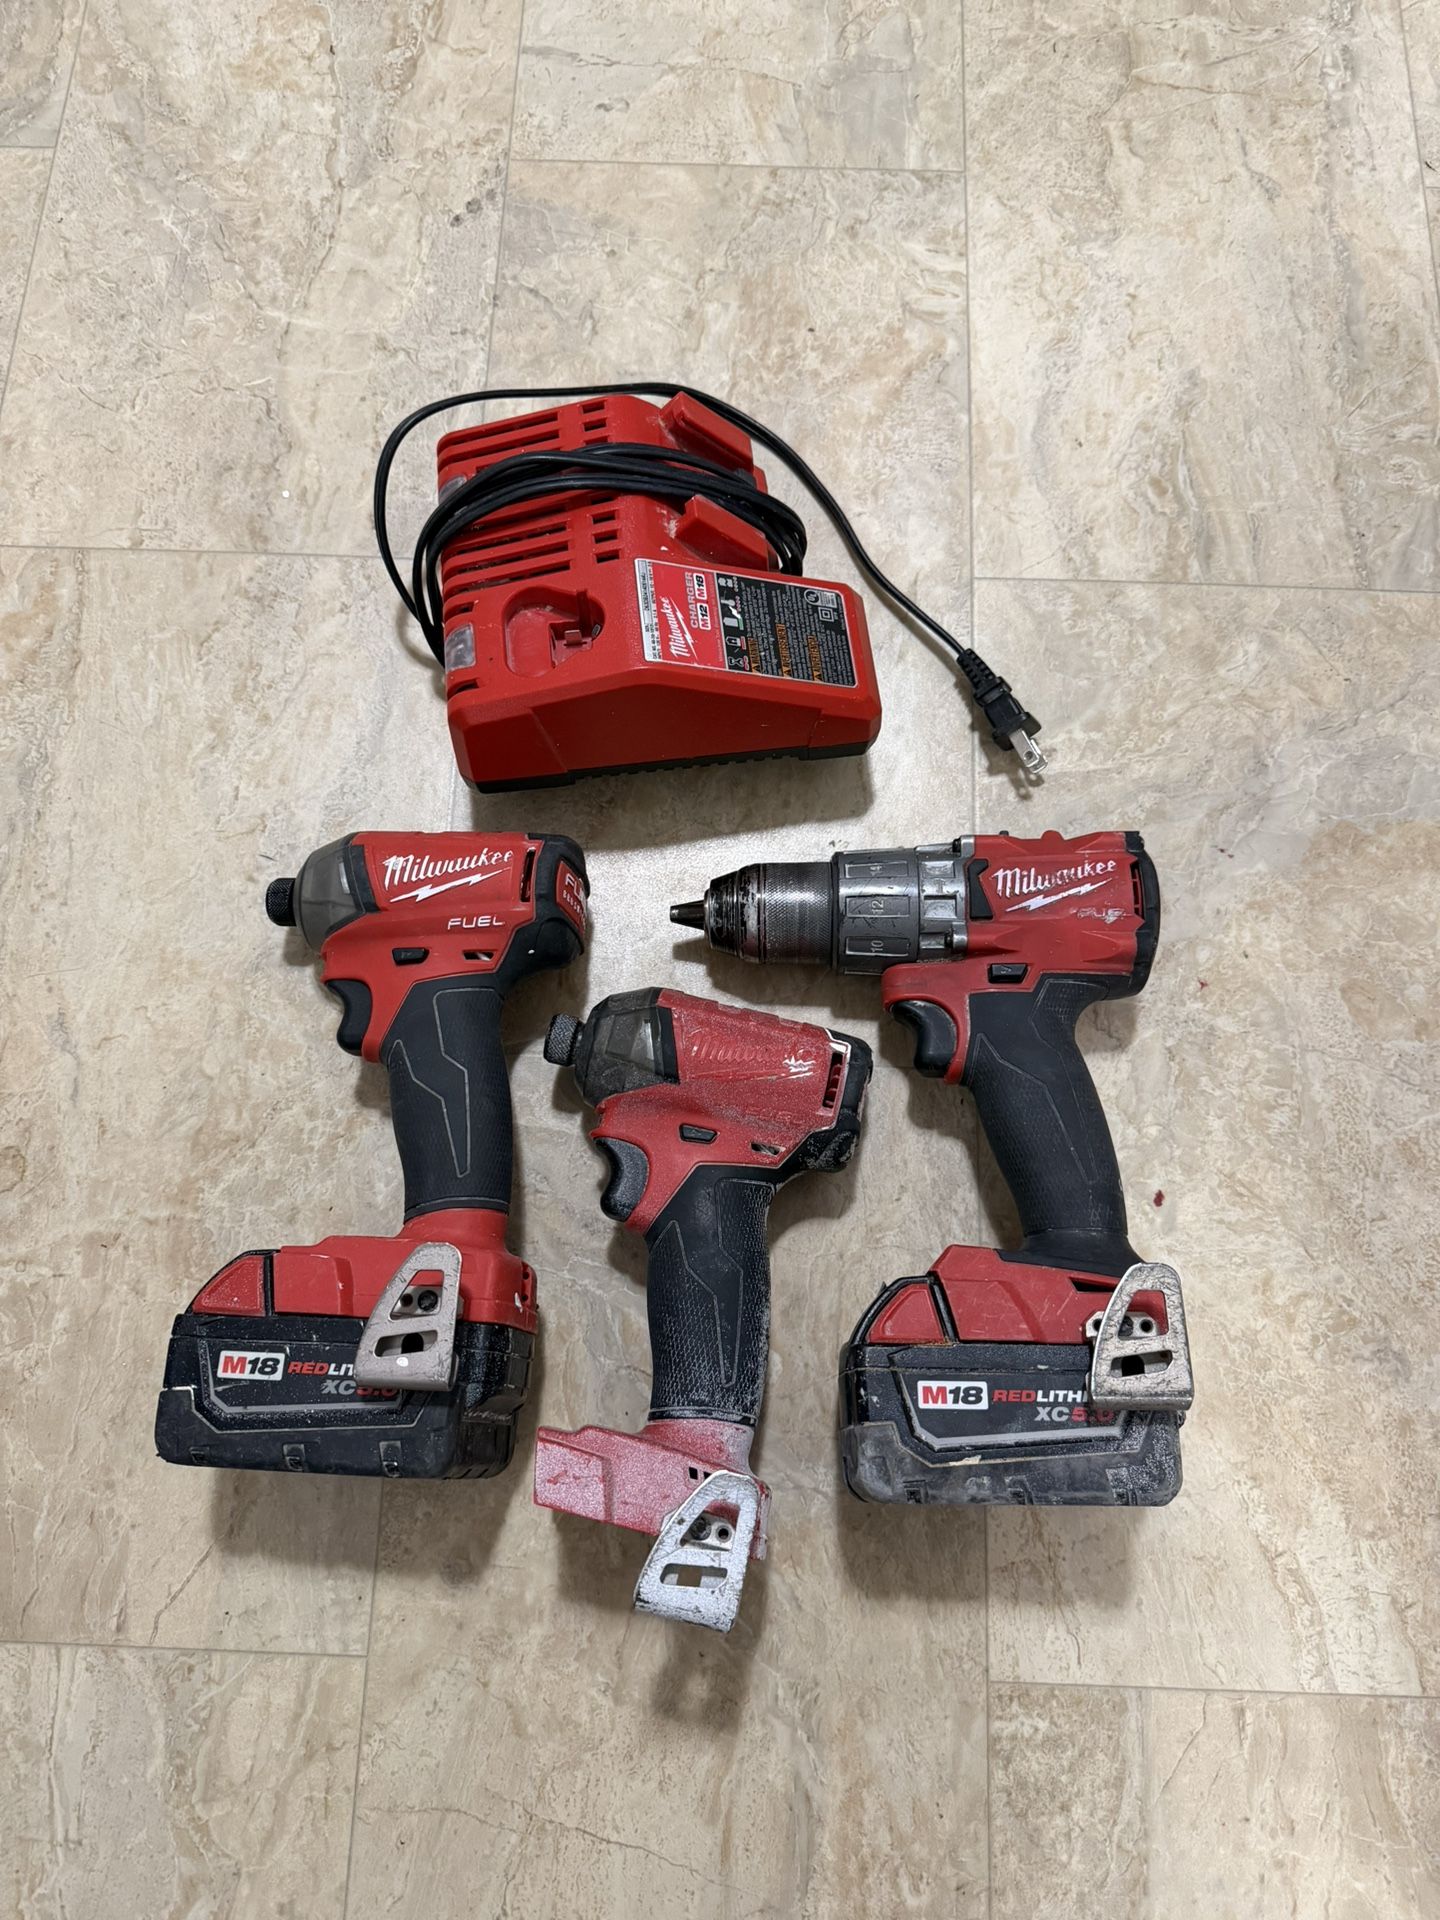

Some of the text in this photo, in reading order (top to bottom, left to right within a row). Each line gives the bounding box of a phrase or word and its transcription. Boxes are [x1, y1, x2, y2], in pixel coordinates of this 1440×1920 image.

[684, 571, 699, 628] CHARGER
[693, 573, 710, 629] M12 M18
[660, 597, 690, 659] Milwaukee
[383, 848, 513, 891] Milwaukee
[991, 860, 1117, 898] Milwaukee
[871, 900, 884, 914] 12
[447, 915, 505, 930] FUEL
[871, 940, 884, 953] 10
[221, 1355, 280, 1376] M18
[287, 1362, 354, 1377] REDLIT
[921, 1385, 983, 1405] M18
[992, 1390, 1089, 1402] REDLITHI
